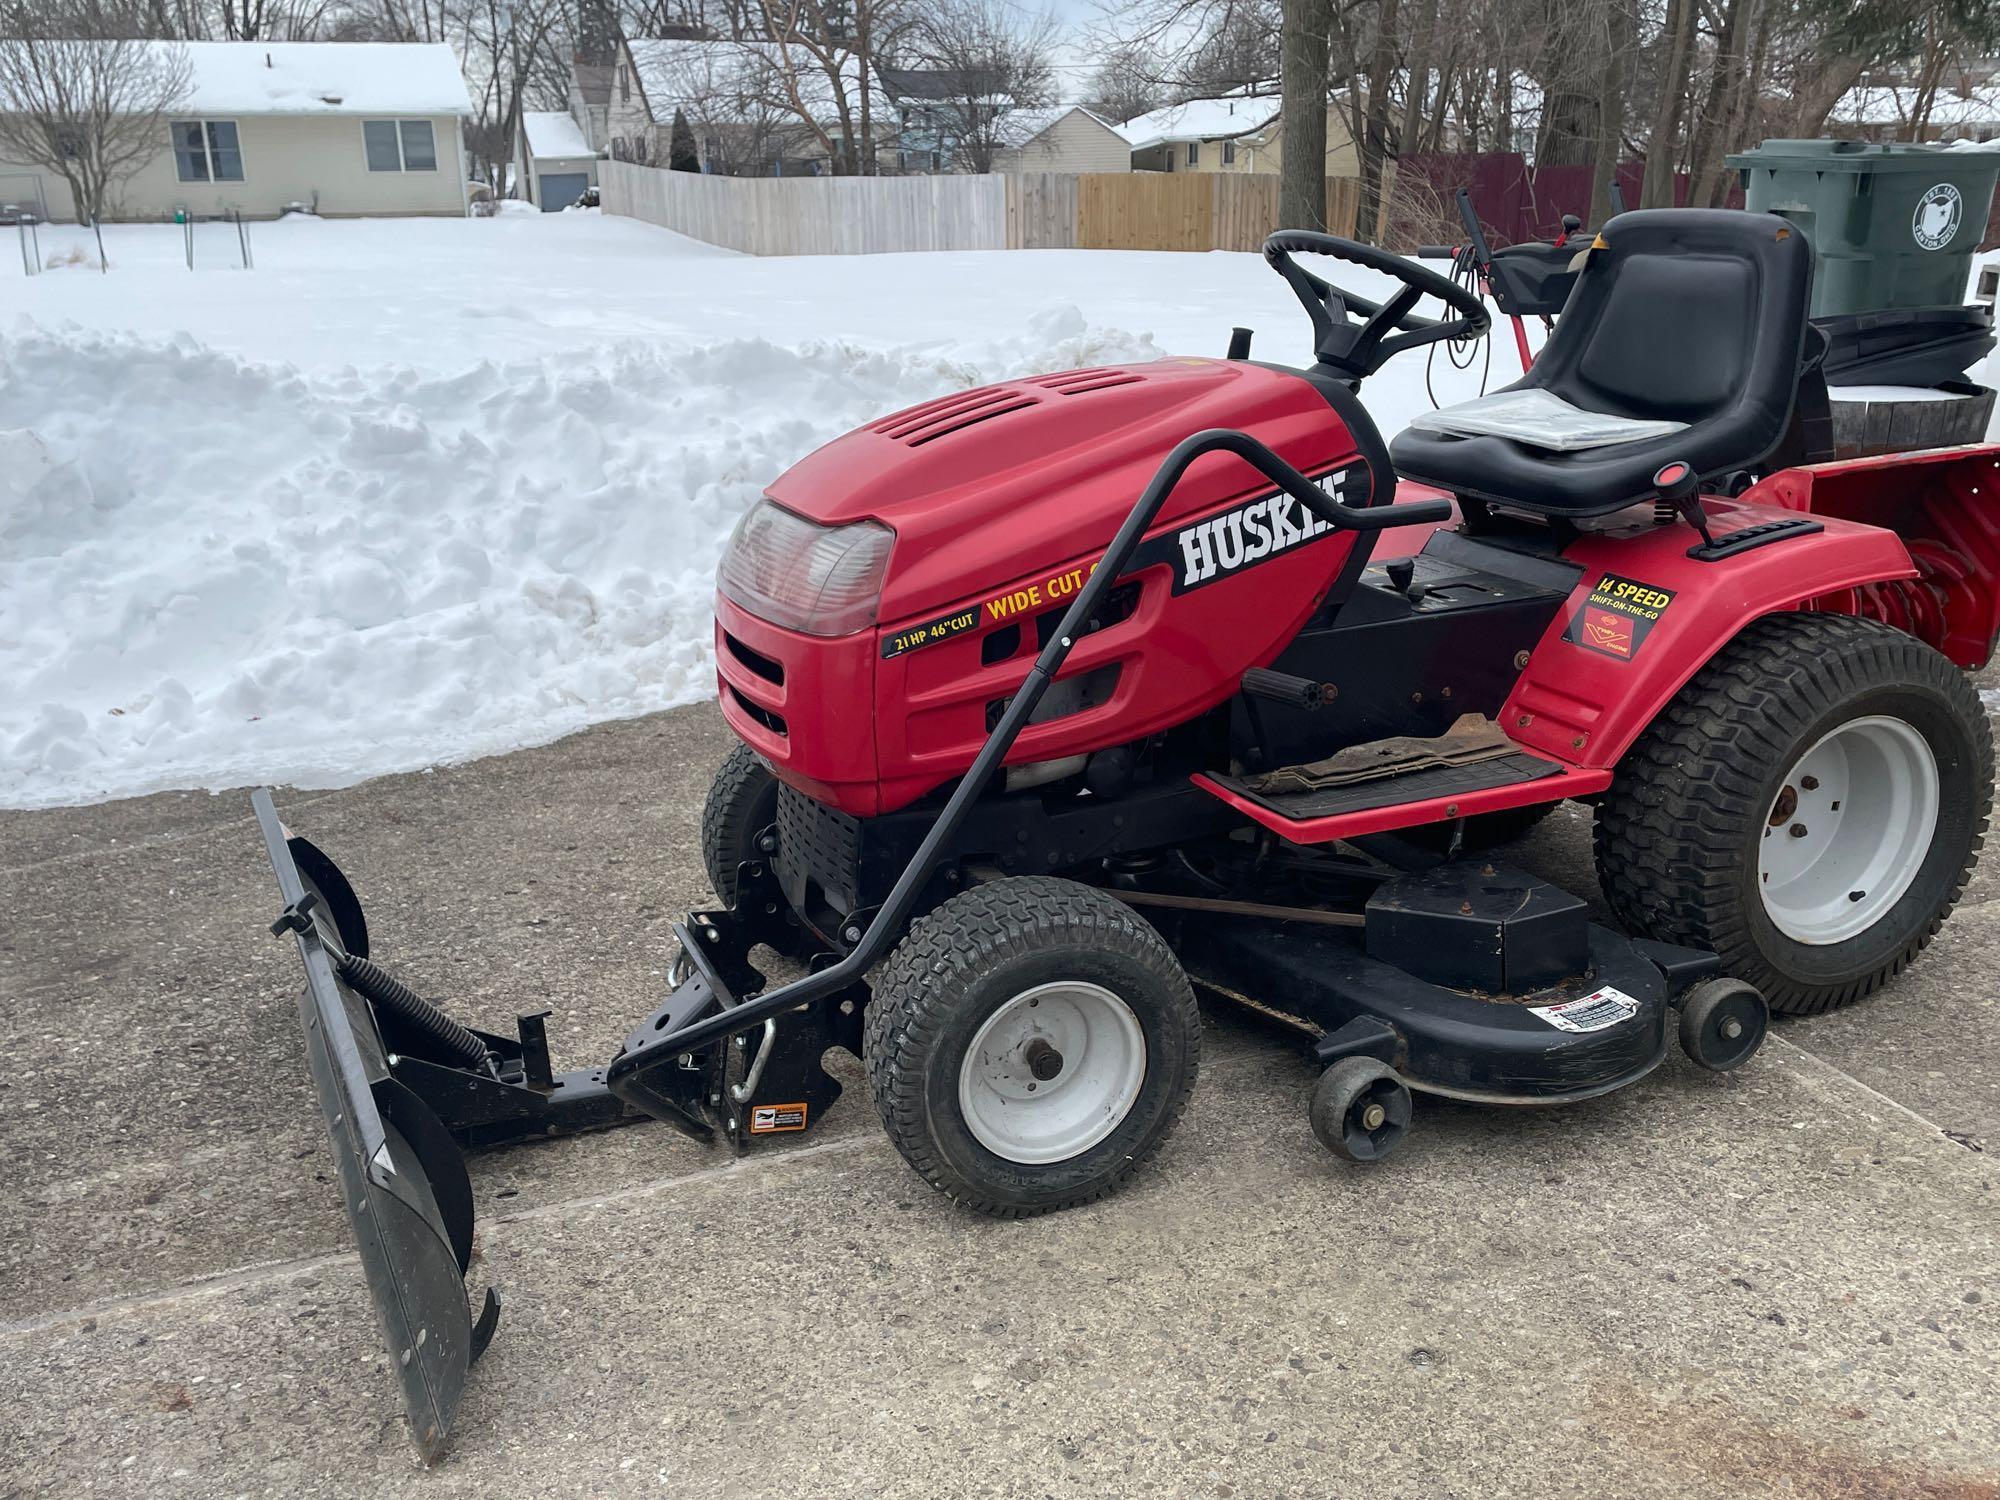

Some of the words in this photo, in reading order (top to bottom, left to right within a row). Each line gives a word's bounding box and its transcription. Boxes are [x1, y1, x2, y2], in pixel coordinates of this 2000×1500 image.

[1940, 223, 1956, 244] OHIO
[986, 586, 1042, 620] WIDE
[1047, 569, 1083, 598] CUT
[1597, 578, 1615, 592] 14
[1613, 583, 1669, 608] SPEED
[1589, 594, 1658, 620] SHIFT-ON-THE-GO
[894, 635, 908, 650] 21
[910, 630, 926, 645] HP
